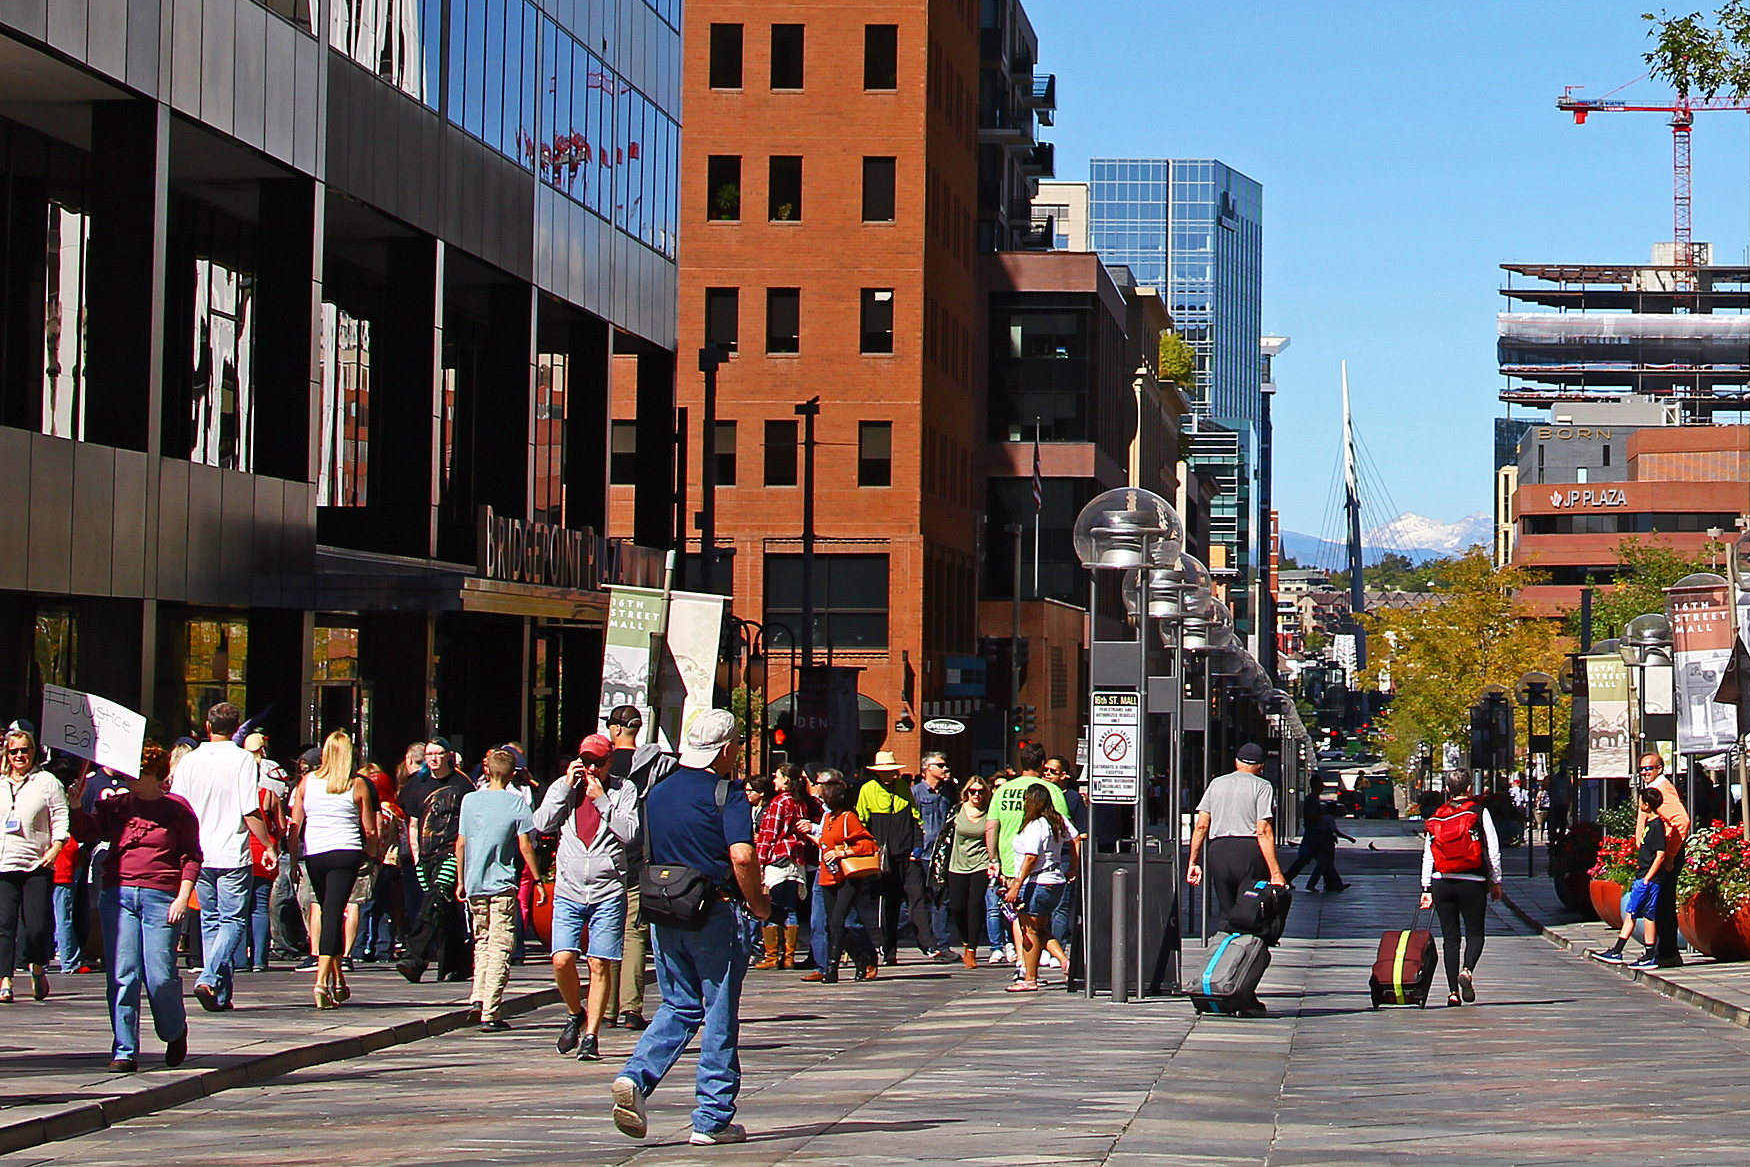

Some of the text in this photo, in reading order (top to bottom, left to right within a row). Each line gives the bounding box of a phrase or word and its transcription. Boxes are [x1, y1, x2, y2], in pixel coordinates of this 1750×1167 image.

[1538, 428, 1612, 440] BORN
[1563, 489, 1628, 508] JP PLAZA
[485, 505, 582, 590] BRIDGEPOINT
[612, 598, 644, 609] 16TH
[1673, 601, 1710, 612] 16TH
[610, 608, 660, 622] STREET
[1674, 611, 1728, 623] STREET
[609, 619, 644, 631] MALL
[1675, 623, 1713, 634] MALL
[1120, 696, 1138, 705] MALL
[45, 686, 132, 733] #Justice
[1001, 800, 1024, 812] STA
